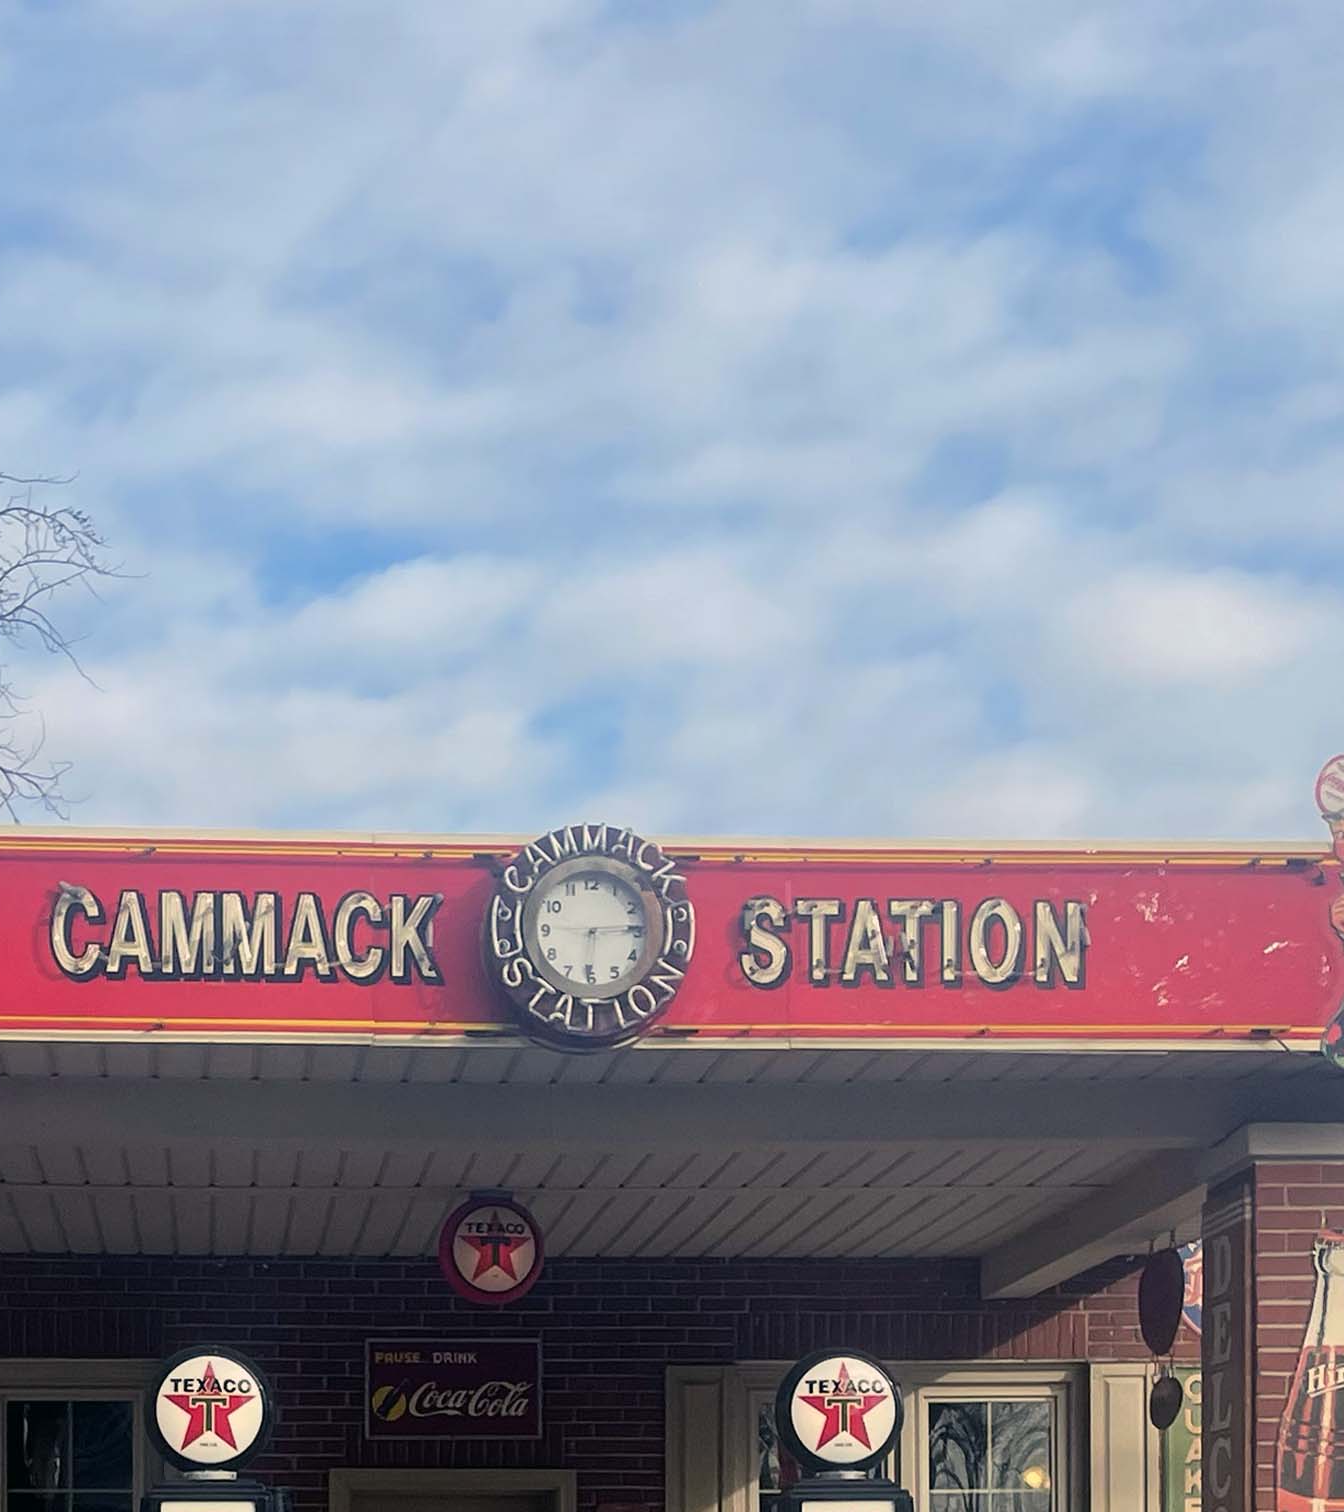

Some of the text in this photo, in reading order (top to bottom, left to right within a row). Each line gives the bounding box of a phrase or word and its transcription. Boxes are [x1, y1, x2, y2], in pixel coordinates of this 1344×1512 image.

[503, 822, 687, 904] CAMMACK
[565, 884, 576, 896] 11
[584, 880, 599, 891] 12
[612, 885, 617, 896] 1
[544, 901, 561, 913] 10
[627, 902, 638, 914] 2
[50, 886, 443, 983] CAMMACK
[541, 925, 551, 936] 9
[740, 896, 1087, 987] STATION
[547, 949, 557, 961] 8
[627, 949, 638, 961] 4
[564, 966, 573, 977] 7
[610, 967, 620, 979] 5
[464, 1222, 525, 1234] TEXACO
[433, 1352, 478, 1364] DRINK
[170, 1378, 252, 1393] TEXACO
[805, 1379, 885, 1394] TEXACO
[409, 1381, 534, 1417] Coca-Cola
